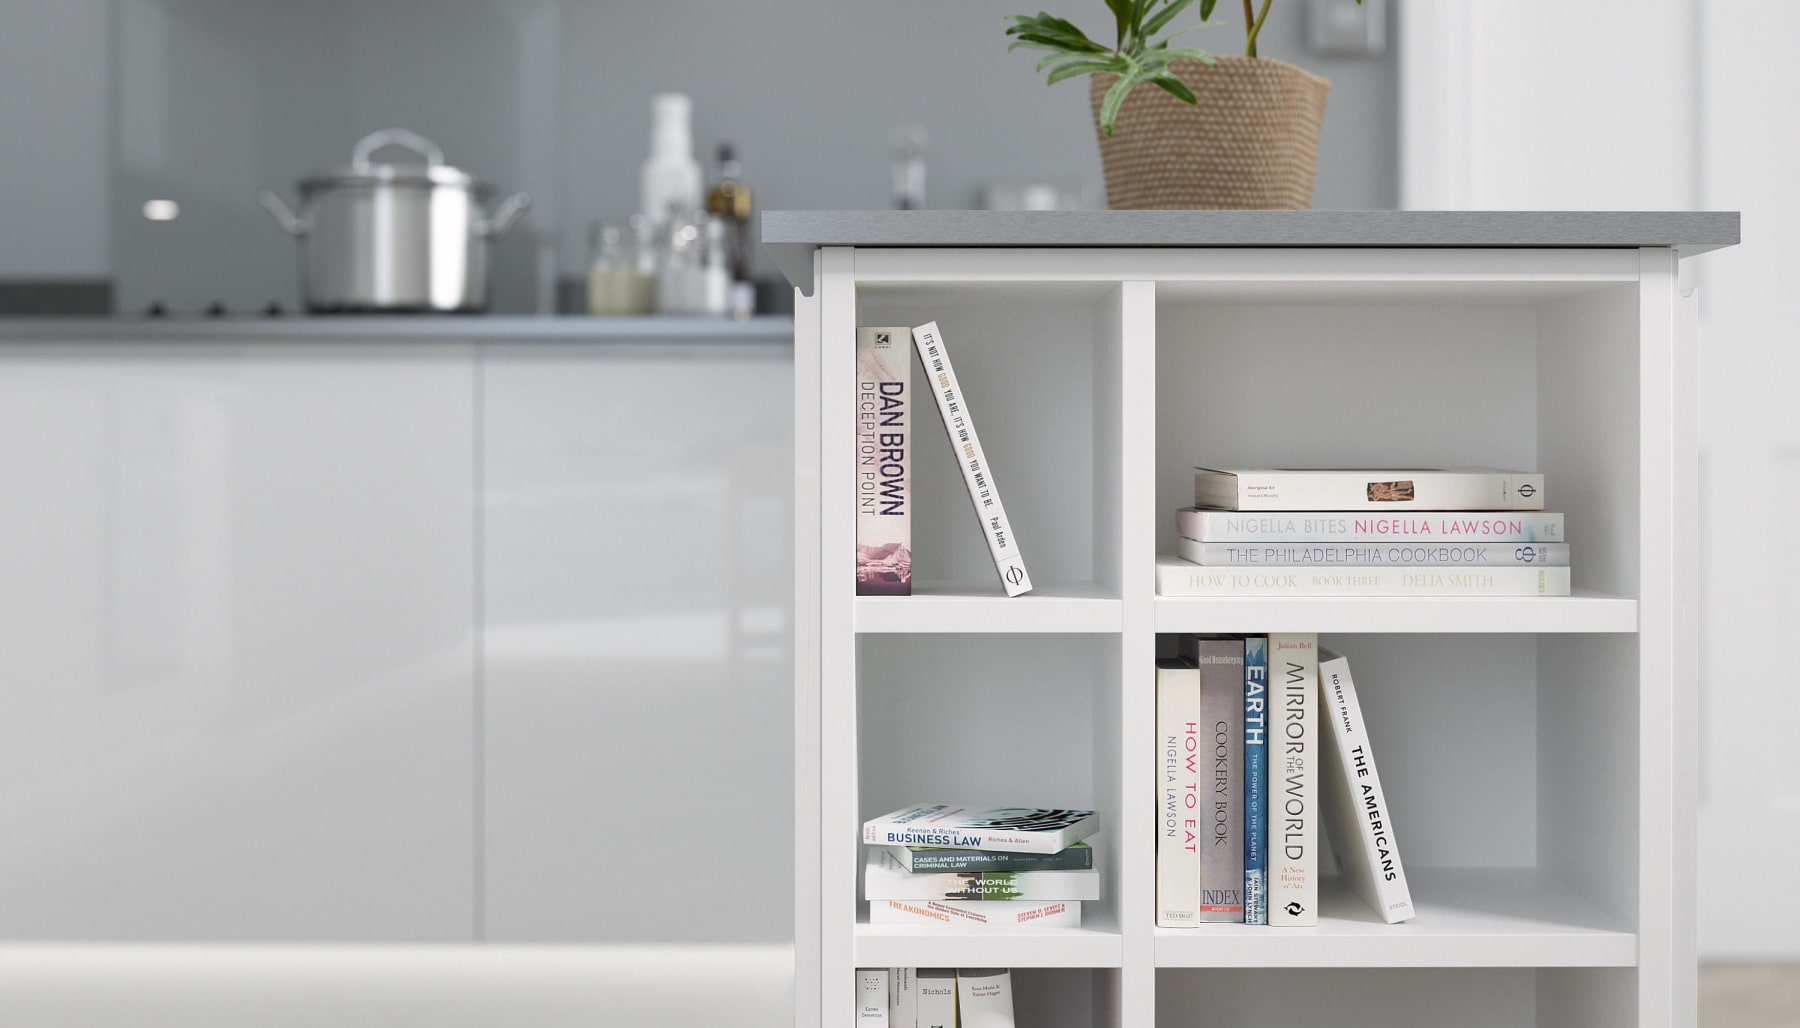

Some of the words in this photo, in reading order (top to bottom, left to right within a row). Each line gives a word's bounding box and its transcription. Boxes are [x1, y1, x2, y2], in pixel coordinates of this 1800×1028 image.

[923, 333, 934, 346] IT'S
[927, 345, 939, 358] NOT
[932, 359, 944, 372] HOW
[938, 373, 950, 388] GOOD
[944, 389, 955, 402] YOU
[879, 382, 904, 427] DAN
[948, 402, 960, 416] ARE,
[861, 382, 875, 466] DECEPTION
[953, 416, 965, 429] IT'S
[958, 429, 970, 442] HOW
[963, 443, 976, 459] GOOD
[969, 459, 980, 472] YOU
[879, 433, 905, 516] BROWN
[974, 472, 987, 489] WANT
[861, 472, 875, 516] POINT
[980, 489, 990, 498] TO
[983, 498, 994, 509] BE.
[990, 516, 1001, 531] Paul
[1227, 519, 1296, 534] NIGELLA
[1304, 519, 1346, 534] BITES
[1354, 519, 1431, 534] NIGELLA
[1442, 520, 1522, 535] LAWSON
[995, 531, 1006, 549] Arden
[1227, 549, 1259, 563] THE
[1265, 548, 1382, 563] PHILADELPHIA
[1388, 548, 1488, 562] COOKBOOK
[1189, 575, 1226, 588] HOW
[1230, 575, 1250, 588] TO
[1254, 575, 1297, 588] COOK
[1312, 576, 1343, 586] BOOK
[1345, 576, 1381, 586] THREE
[1402, 575, 1444, 587] DELIA
[1449, 575, 1493, 587] SMITH
[1276, 642, 1298, 650] Julian
[1246, 665, 1264, 745] EARTH
[1286, 662, 1304, 754] MIRROR
[1331, 674, 1344, 704] ROBERT
[1340, 706, 1352, 733] FRANK
[1185, 722, 1197, 774] HOW
[1167, 736, 1177, 783] NIGELLA
[1215, 721, 1228, 797] COOKERY
[1286, 756, 1295, 774] THE
[1295, 758, 1304, 770] OF
[1185, 783, 1196, 809] TO
[1166, 788, 1177, 837] LAWSON
[1251, 801, 1258, 813] OF
[1351, 745, 1369, 778] THE
[1361, 784, 1396, 881] AMERICANS
[1215, 801, 1228, 847] BOOK
[1285, 774, 1304, 860] WORLD
[887, 833, 950, 845] BUSINESS
[954, 836, 982, 846] LAW
[1185, 819, 1196, 853] EAT
[1202, 889, 1240, 905] INDEX
[889, 900, 950, 922] FREAKONOMICS
[1388, 902, 1408, 910] STEIDL
